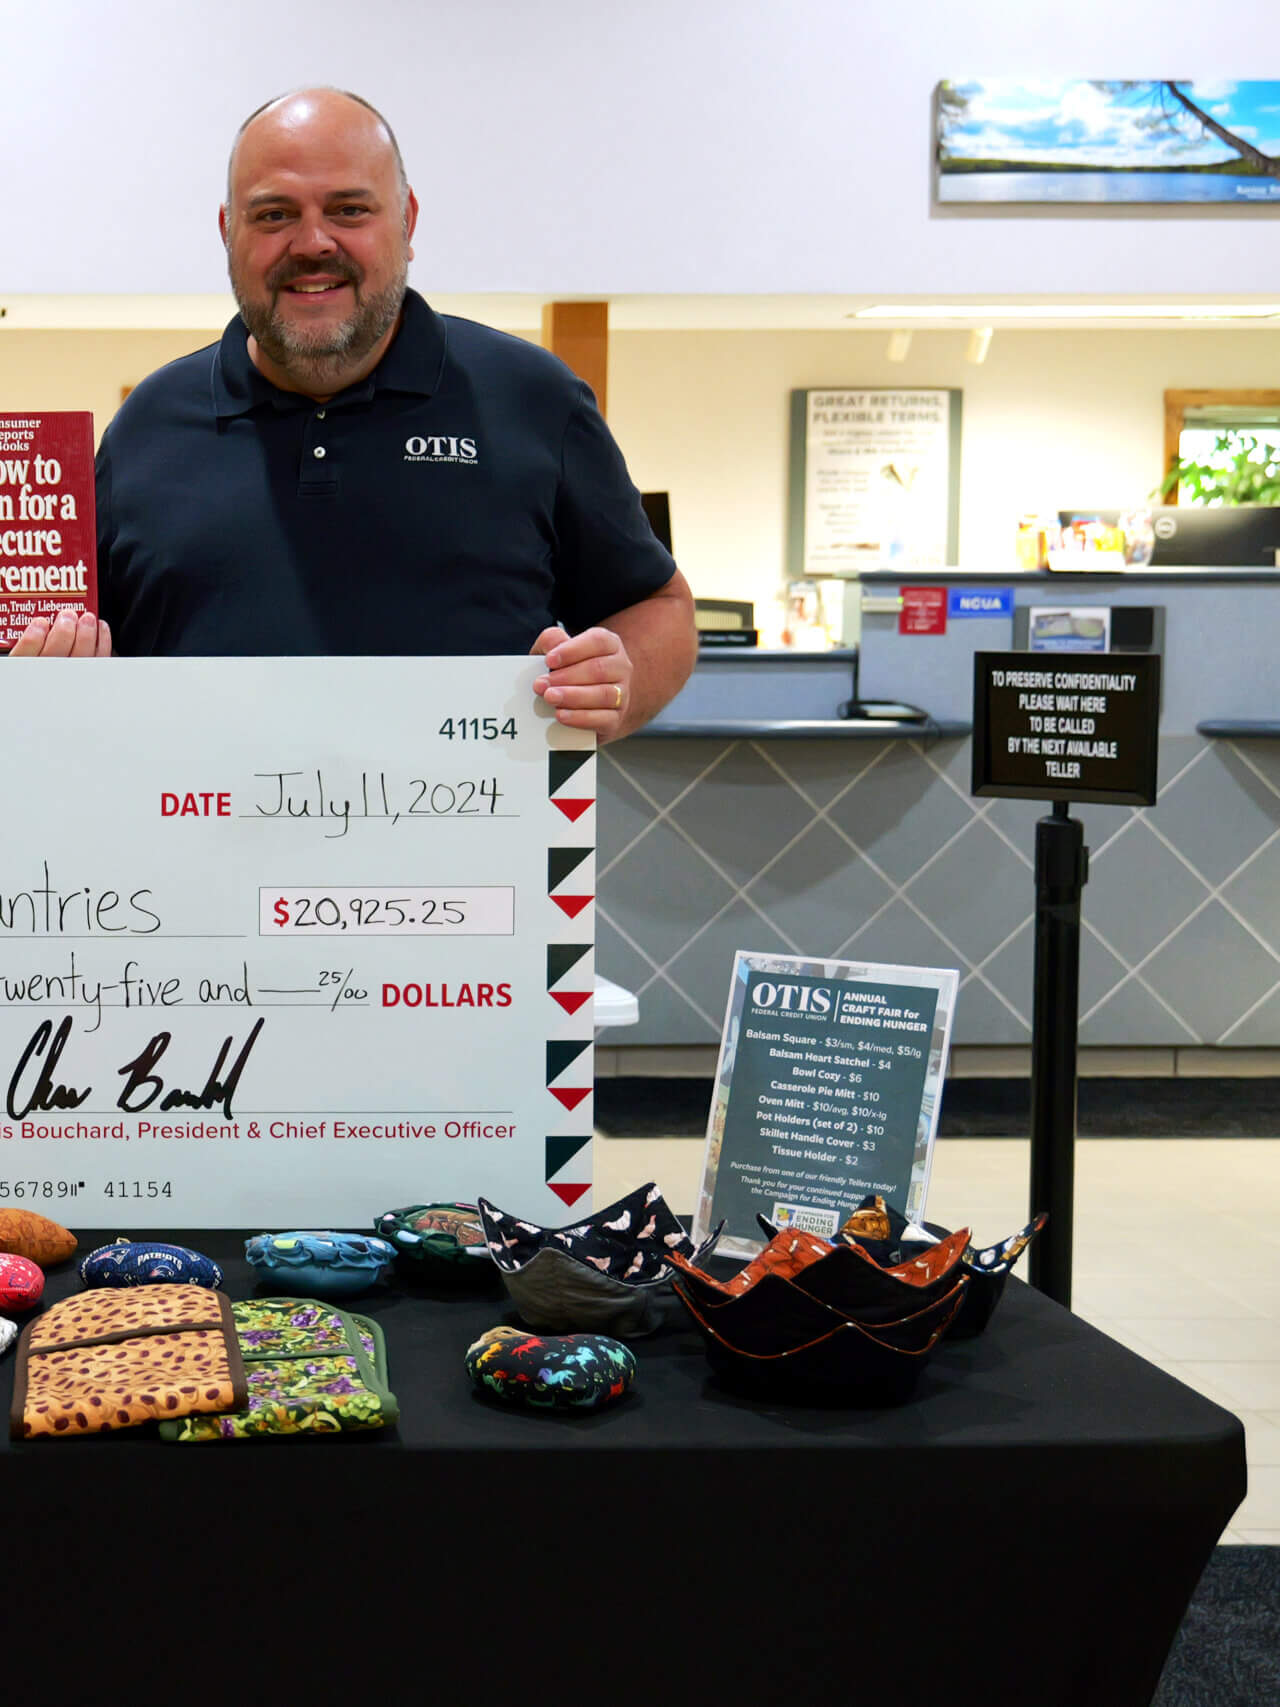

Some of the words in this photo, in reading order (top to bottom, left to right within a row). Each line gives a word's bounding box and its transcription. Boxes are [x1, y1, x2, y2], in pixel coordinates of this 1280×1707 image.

[405, 436, 477, 458] OTIS
[33, 454, 62, 485] to
[19, 484, 58, 520] for
[60, 493, 77, 520] a
[11, 601, 36, 614] Trudy
[38, 600, 87, 613] Lieberman,
[960, 597, 1002, 610] NCUA
[992, 671, 1005, 687] TO
[1006, 672, 1053, 688] PRESERVE
[1055, 673, 1136, 691] CONFIDENTIALITY
[1019, 694, 1054, 711] PLEASE
[1056, 695, 1079, 712] WAIT
[1080, 697, 1106, 713] HERE
[438, 718, 518, 741] 41154
[1029, 716, 1042, 732] TO
[1044, 717, 1056, 733] BE
[1058, 718, 1095, 735] CALLED
[1008, 737, 1021, 753] BY
[1023, 738, 1040, 754] THE
[1041, 739, 1066, 755] NEXT
[1067, 740, 1117, 759] AVAILABLE
[1046, 761, 1080, 778] TELLER
[160, 793, 231, 817] DATE
[254, 770, 350, 838] July
[273, 897, 467, 931] $20,925.25
[199, 961, 253, 1007] and
[381, 983, 513, 1008] DOLLARS
[752, 982, 831, 1013] OTIS
[843, 992, 887, 1004] ANNUAL
[751, 1008, 778, 1016] FEDERAL
[780, 1011, 803, 1019] CREDIT
[805, 1013, 827, 1021] UNION
[842, 1003, 876, 1015] CRAFT
[878, 1006, 901, 1018] FAIR
[903, 1009, 919, 1019] for
[840, 1015, 880, 1027] ENDING
[883, 1020, 927, 1032] HUNGER
[746, 1029, 780, 1041] Balsam
[783, 1033, 816, 1045] Square
[897, 1045, 921, 1058] $5/lg
[769, 1048, 803, 1060] Balsam
[805, 1052, 831, 1063] Heart
[834, 1055, 869, 1068] Satchel
[878, 1060, 891, 1070] $4
[792, 1067, 816, 1077] Bowl
[818, 1070, 840, 1082] Cozy
[849, 1073, 862, 1083] $6
[771, 1080, 816, 1094] Casserole
[818, 1086, 833, 1096] Pie
[835, 1088, 855, 1099] Mitt
[863, 1091, 879, 1101] $10
[759, 1095, 783, 1106] Oven
[785, 1098, 804, 1109] Mitt
[21, 1121, 130, 1142] Bouchard,
[137, 1121, 240, 1140] President
[247, 1121, 262, 1140] &
[269, 1121, 327, 1140] Chief
[333, 1121, 436, 1140] Executive
[444, 1121, 516, 1140] Officer
[756, 1111, 772, 1121] Pot
[774, 1113, 810, 1126] Holders
[813, 1117, 832, 1129] (set
[834, 1121, 845, 1130] of
[847, 1122, 858, 1134] 2)
[867, 1124, 884, 1135] $10
[760, 1128, 789, 1139] Skillet
[791, 1131, 824, 1144] Handle
[826, 1136, 854, 1148] Cover
[863, 1140, 876, 1151] $3
[772, 1145, 802, 1158] Tissue
[804, 1150, 837, 1162] Holder
[845, 1155, 858, 1166] $2
[730, 1161, 762, 1172] Purchase
[762, 1166, 780, 1175] from
[781, 1170, 795, 1178] one
[795, 1170, 805, 1178] of
[805, 1172, 818, 1180] our
[819, 1174, 847, 1186] friendly
[848, 1178, 872, 1189] Tellers
[872, 1182, 897, 1193] today!
[103, 1181, 173, 1198] 41154
[795, 1222, 833, 1235] HUNGER
[796, 1215, 833, 1228] ENDING
[137, 1252, 183, 1271] PATRIOTS
